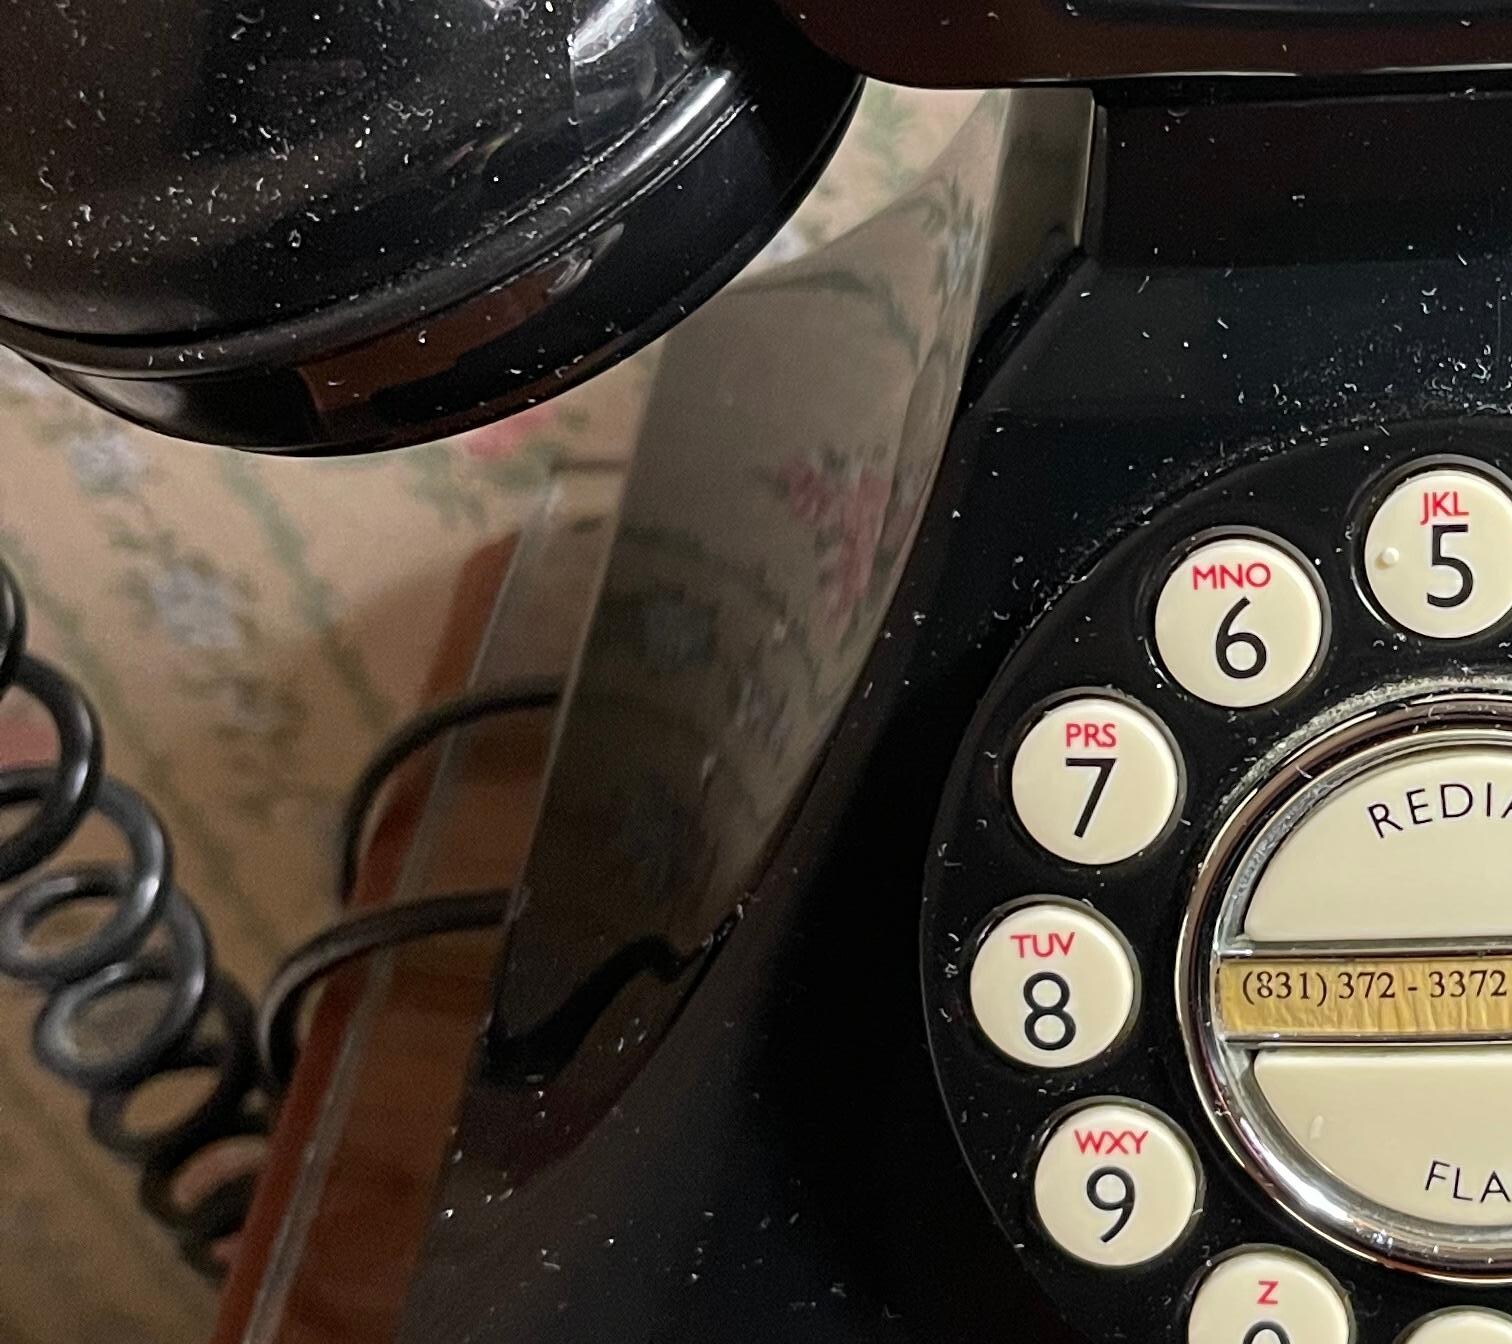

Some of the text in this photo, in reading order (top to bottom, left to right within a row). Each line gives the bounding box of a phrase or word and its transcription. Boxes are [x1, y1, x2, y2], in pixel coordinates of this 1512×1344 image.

[1421, 491, 1469, 526] JKL
[1191, 561, 1273, 592] MNO
[1426, 523, 1474, 608] 5
[1215, 596, 1267, 680] 6
[1064, 721, 1118, 750] PRS
[1065, 757, 1117, 839] 7
[1011, 931, 1075, 959] TUV
[1242, 971, 1328, 1007] (831)
[1337, 971, 1396, 999] 372
[1429, 969, 1508, 998] 3372
[1022, 971, 1077, 1052] 8
[1074, 1130, 1148, 1155] WXY
[1086, 1166, 1136, 1243] 9
[1257, 1280, 1279, 1306] Z
